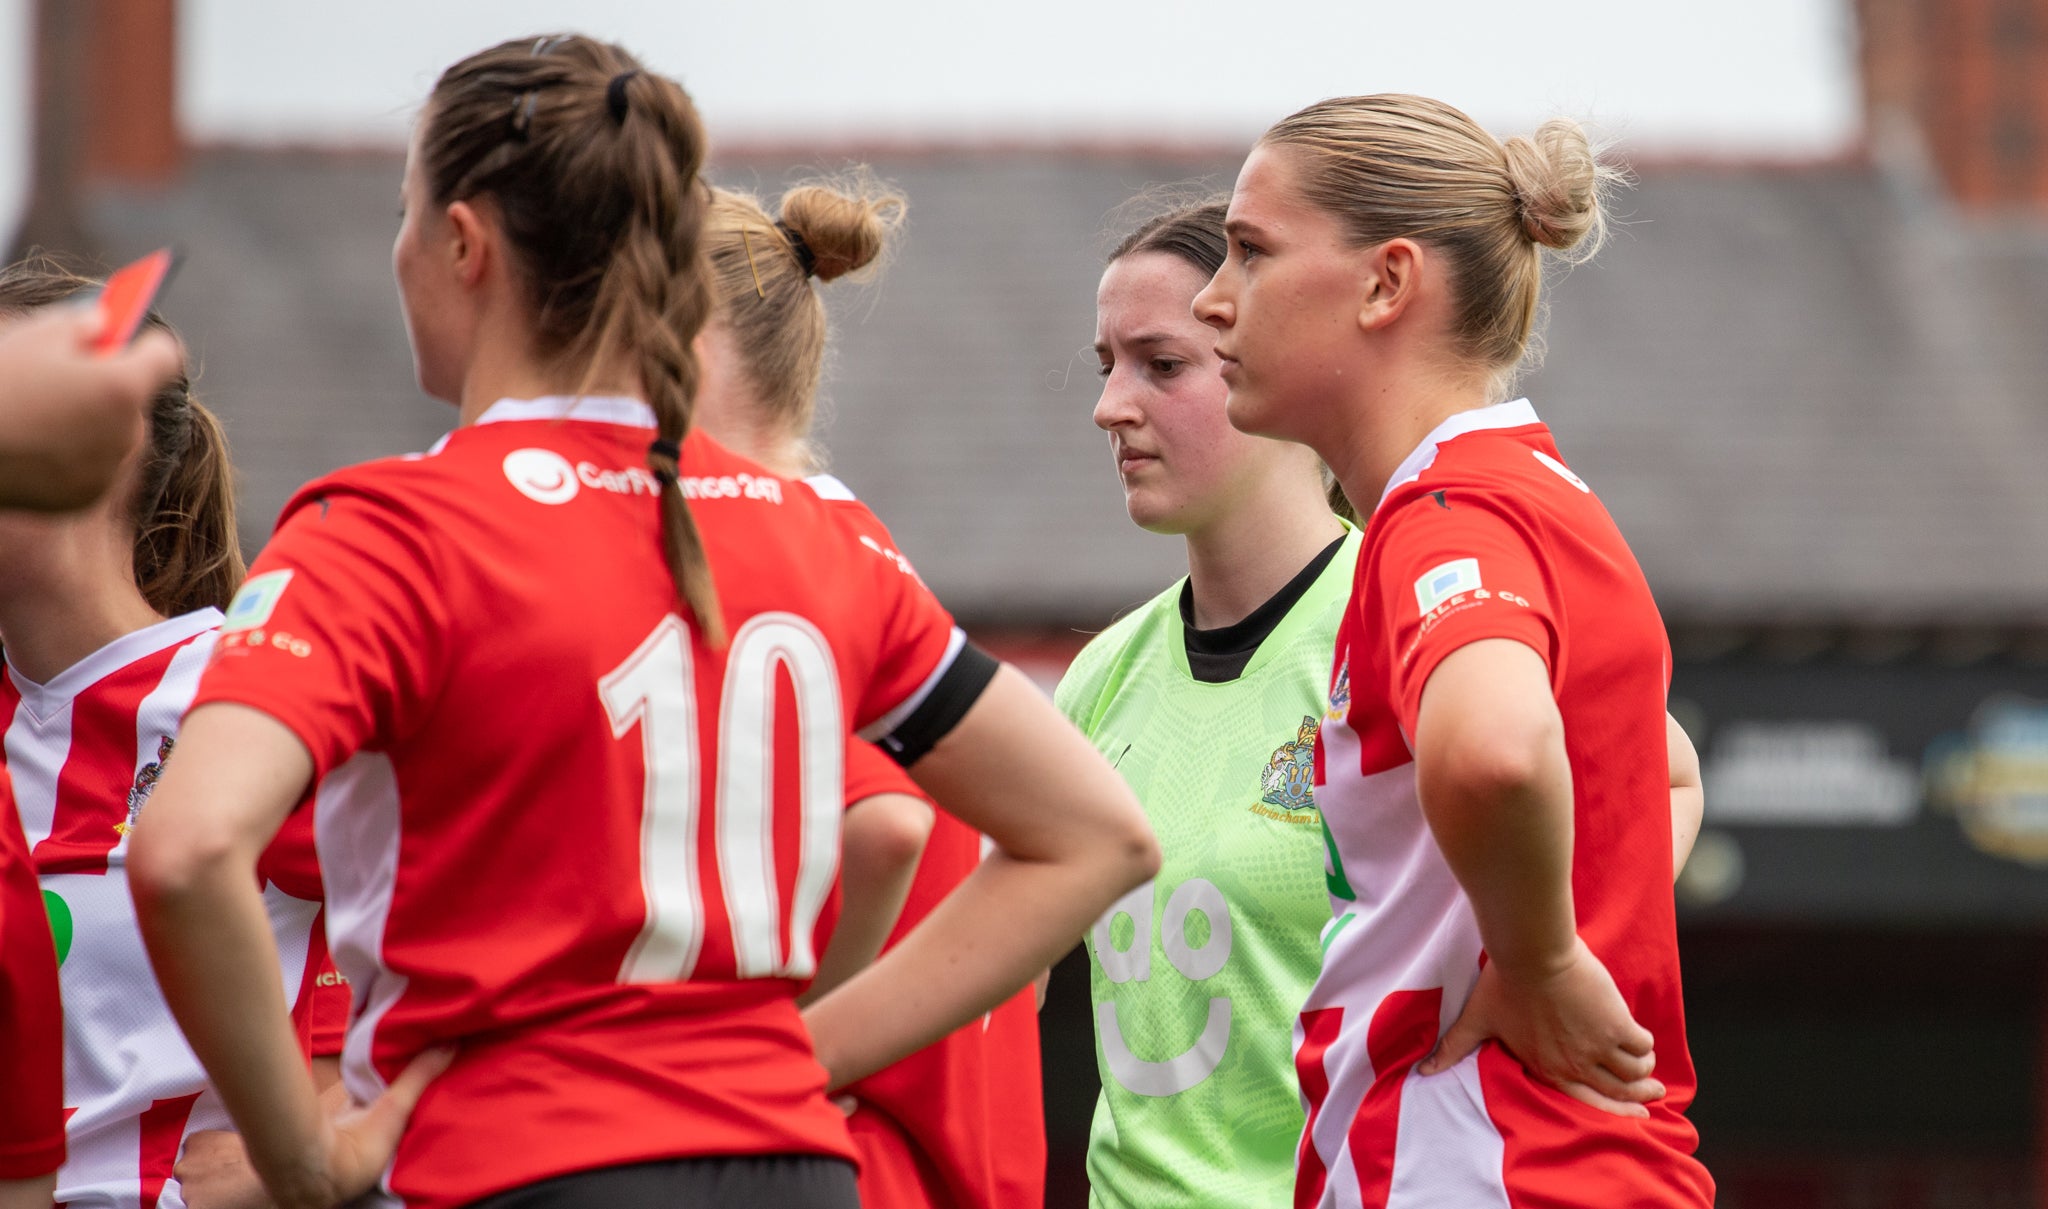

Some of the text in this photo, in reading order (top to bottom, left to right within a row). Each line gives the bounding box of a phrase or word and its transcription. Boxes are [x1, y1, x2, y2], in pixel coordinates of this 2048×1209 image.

[598, 612, 845, 986] 10
[1248, 802, 1312, 824] Altrincham
[1093, 877, 1233, 984] ao
